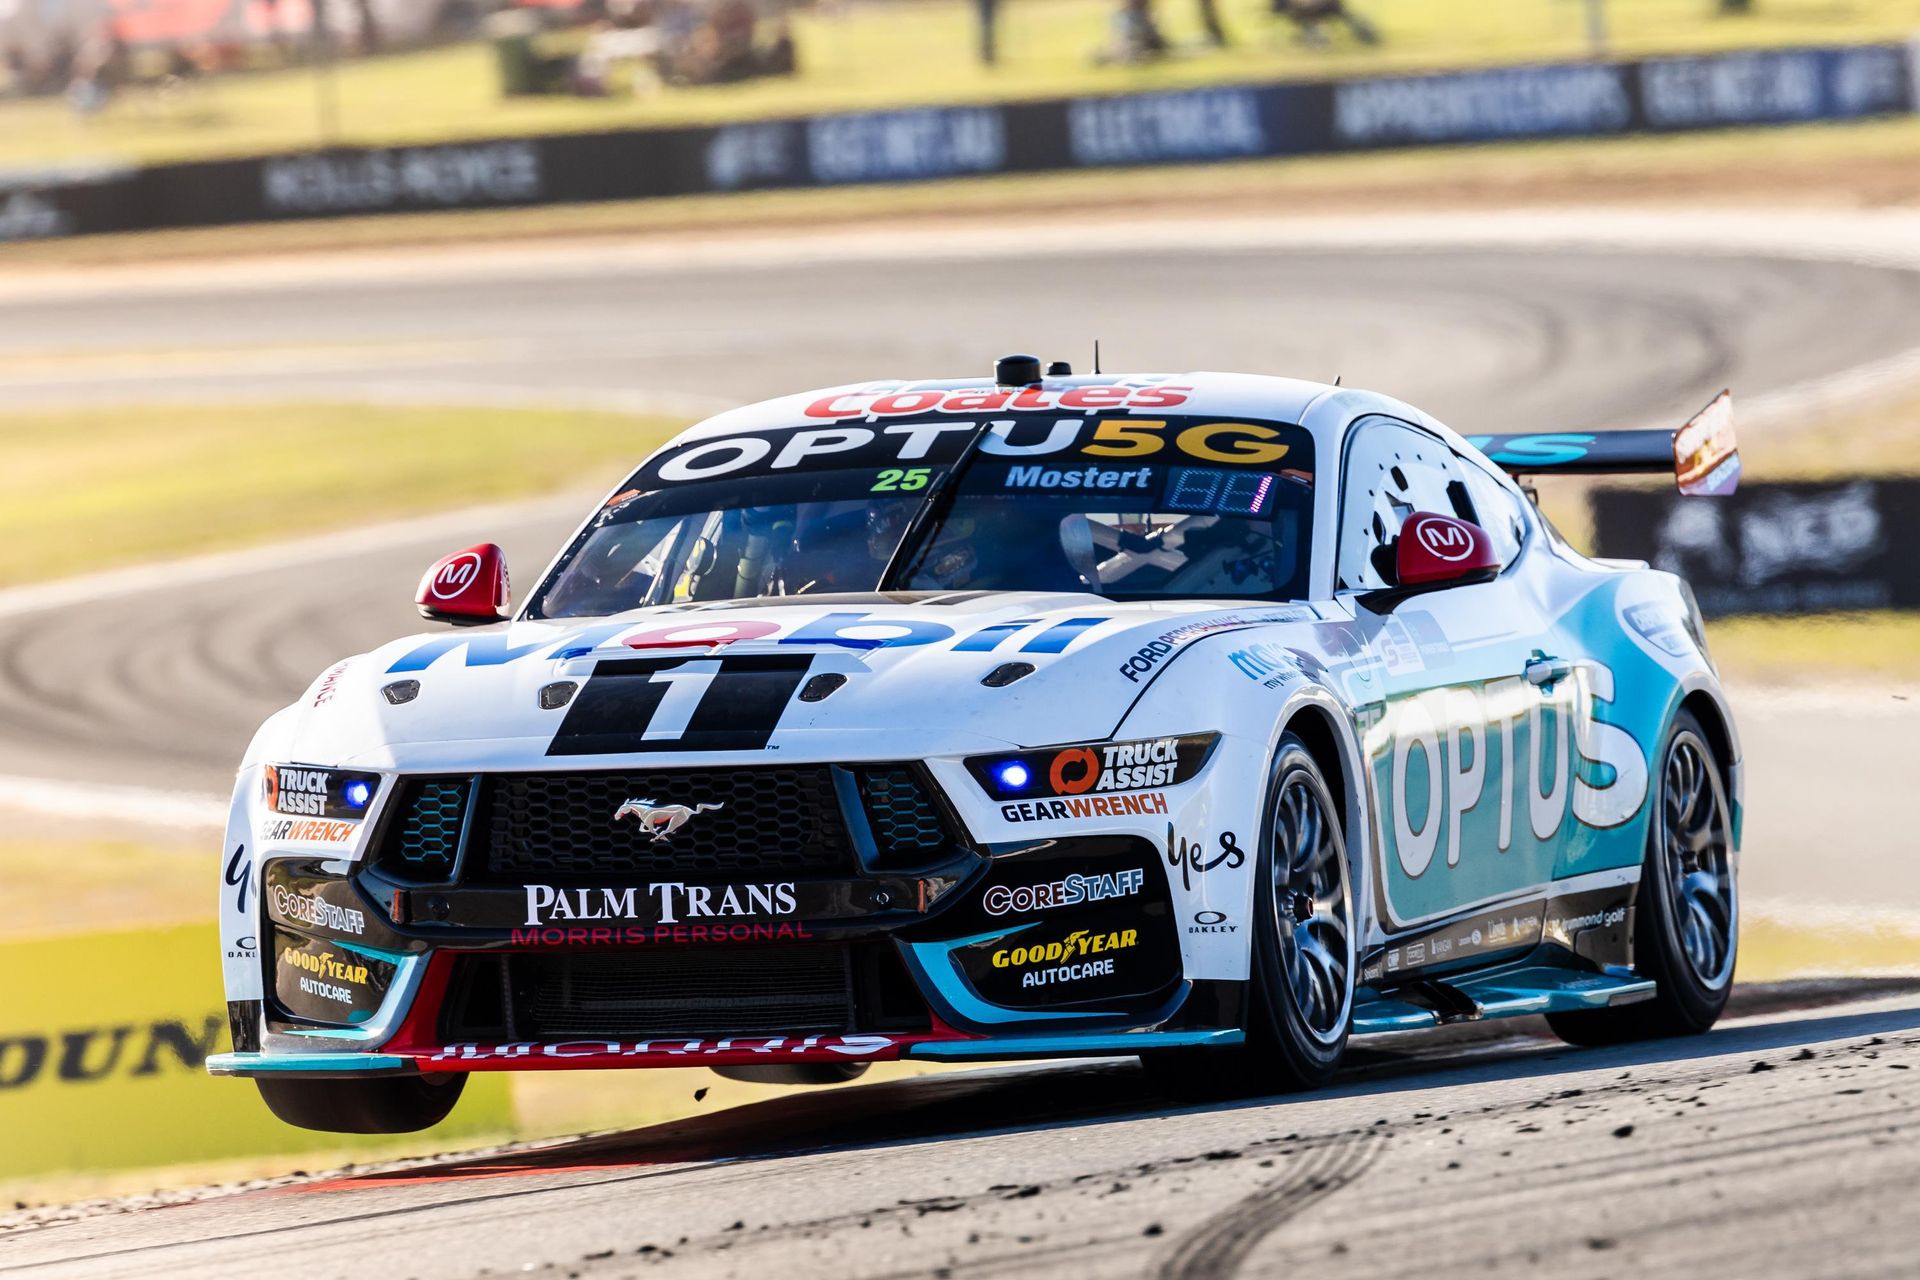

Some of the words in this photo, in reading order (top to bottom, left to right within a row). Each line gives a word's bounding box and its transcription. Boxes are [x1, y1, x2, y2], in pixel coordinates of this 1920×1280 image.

[870, 468, 932, 492] 25
[1005, 466, 1152, 488] Mostert
[640, 660, 716, 741] 1
[1103, 739, 1179, 767] TRUCK
[279, 769, 329, 794] TRUCK
[1096, 762, 1178, 791] ASSIST
[1392, 659, 1648, 880] OPTUS
[277, 791, 328, 816] ASSIST
[1001, 793, 1169, 822] GEARWRENCH
[523, 884, 638, 926] PALM
[649, 882, 797, 923] TRANS
[1604, 907, 1625, 927] golf
[511, 927, 645, 946] MORRIS
[654, 922, 813, 944] PERSONAL
[1188, 925, 1238, 933] OAKLEY
[1022, 959, 1114, 988] AUTOCARE
[300, 976, 353, 1004] AUTOCARE
